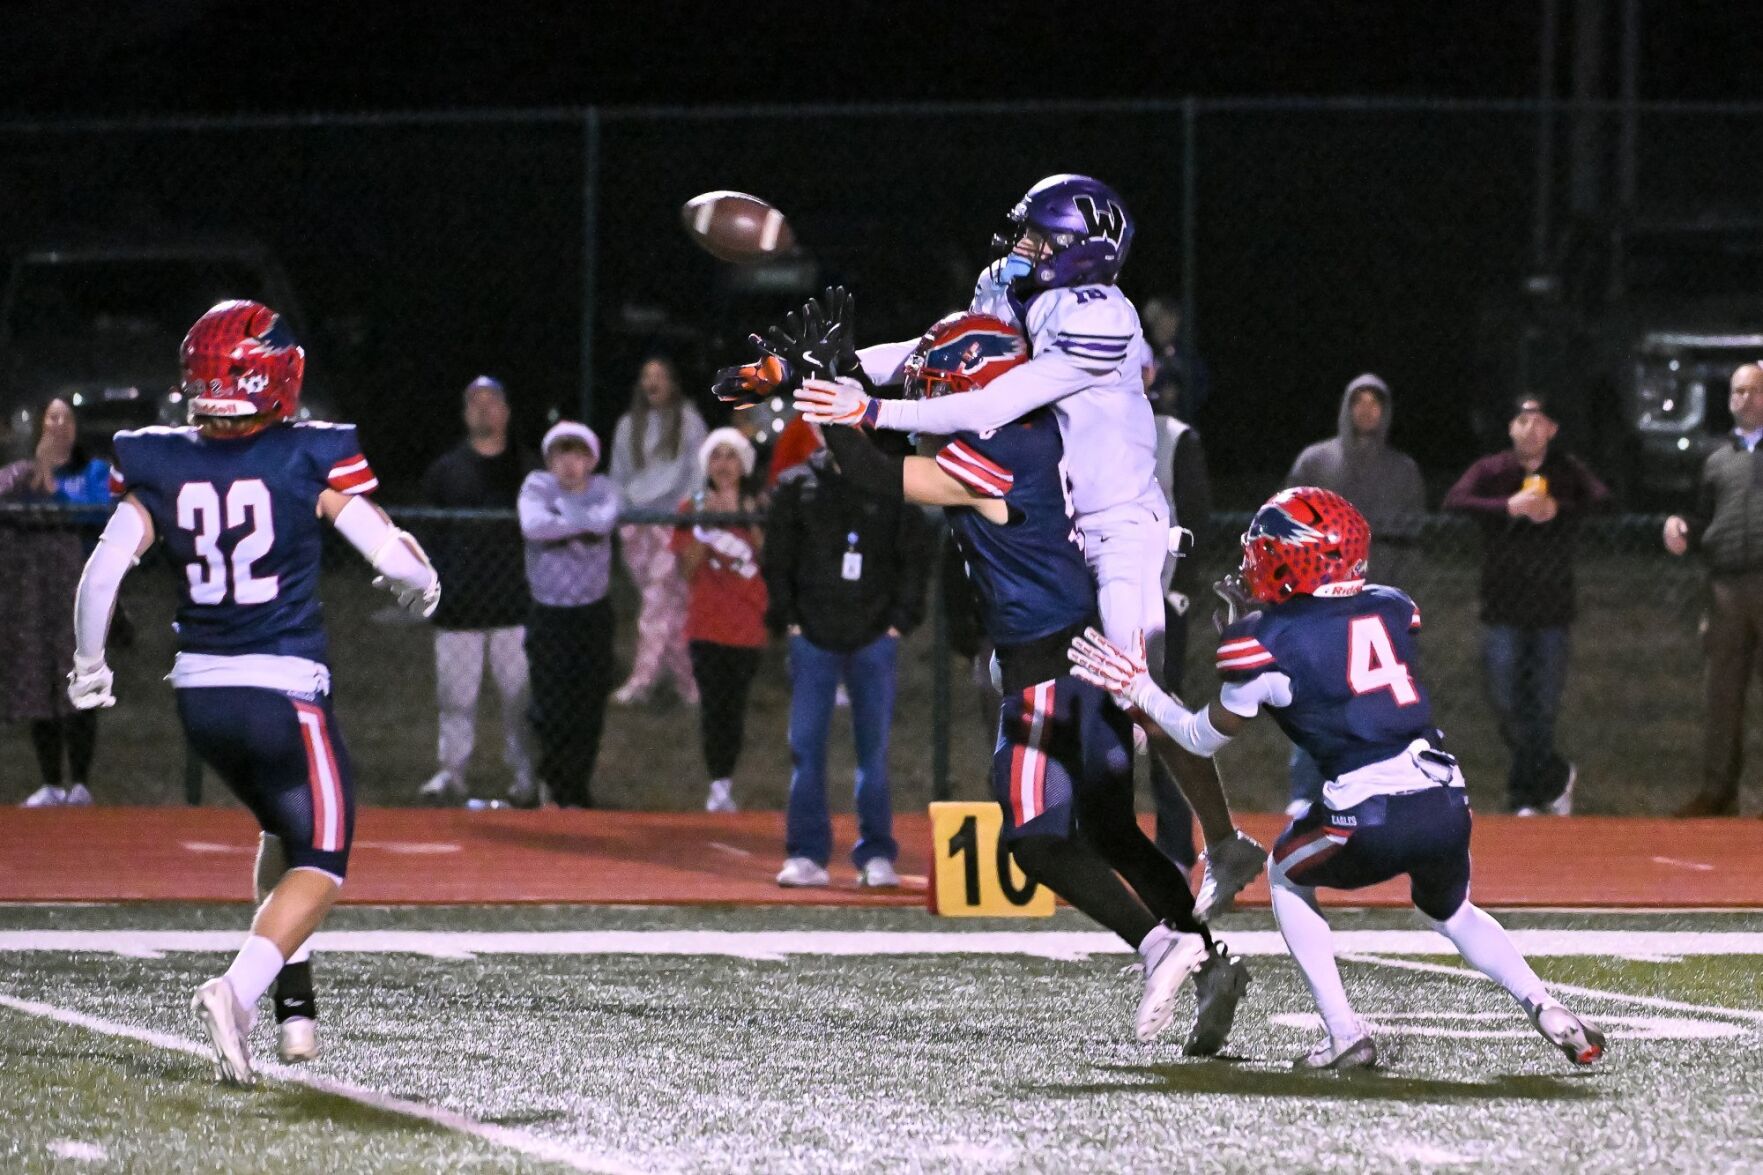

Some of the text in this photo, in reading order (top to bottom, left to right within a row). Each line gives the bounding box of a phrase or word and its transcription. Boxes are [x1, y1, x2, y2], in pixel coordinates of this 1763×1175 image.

[1072, 194, 1127, 251] W
[177, 479, 279, 605] 32
[1346, 613, 1420, 708] 4
[948, 815, 1039, 906] 10
